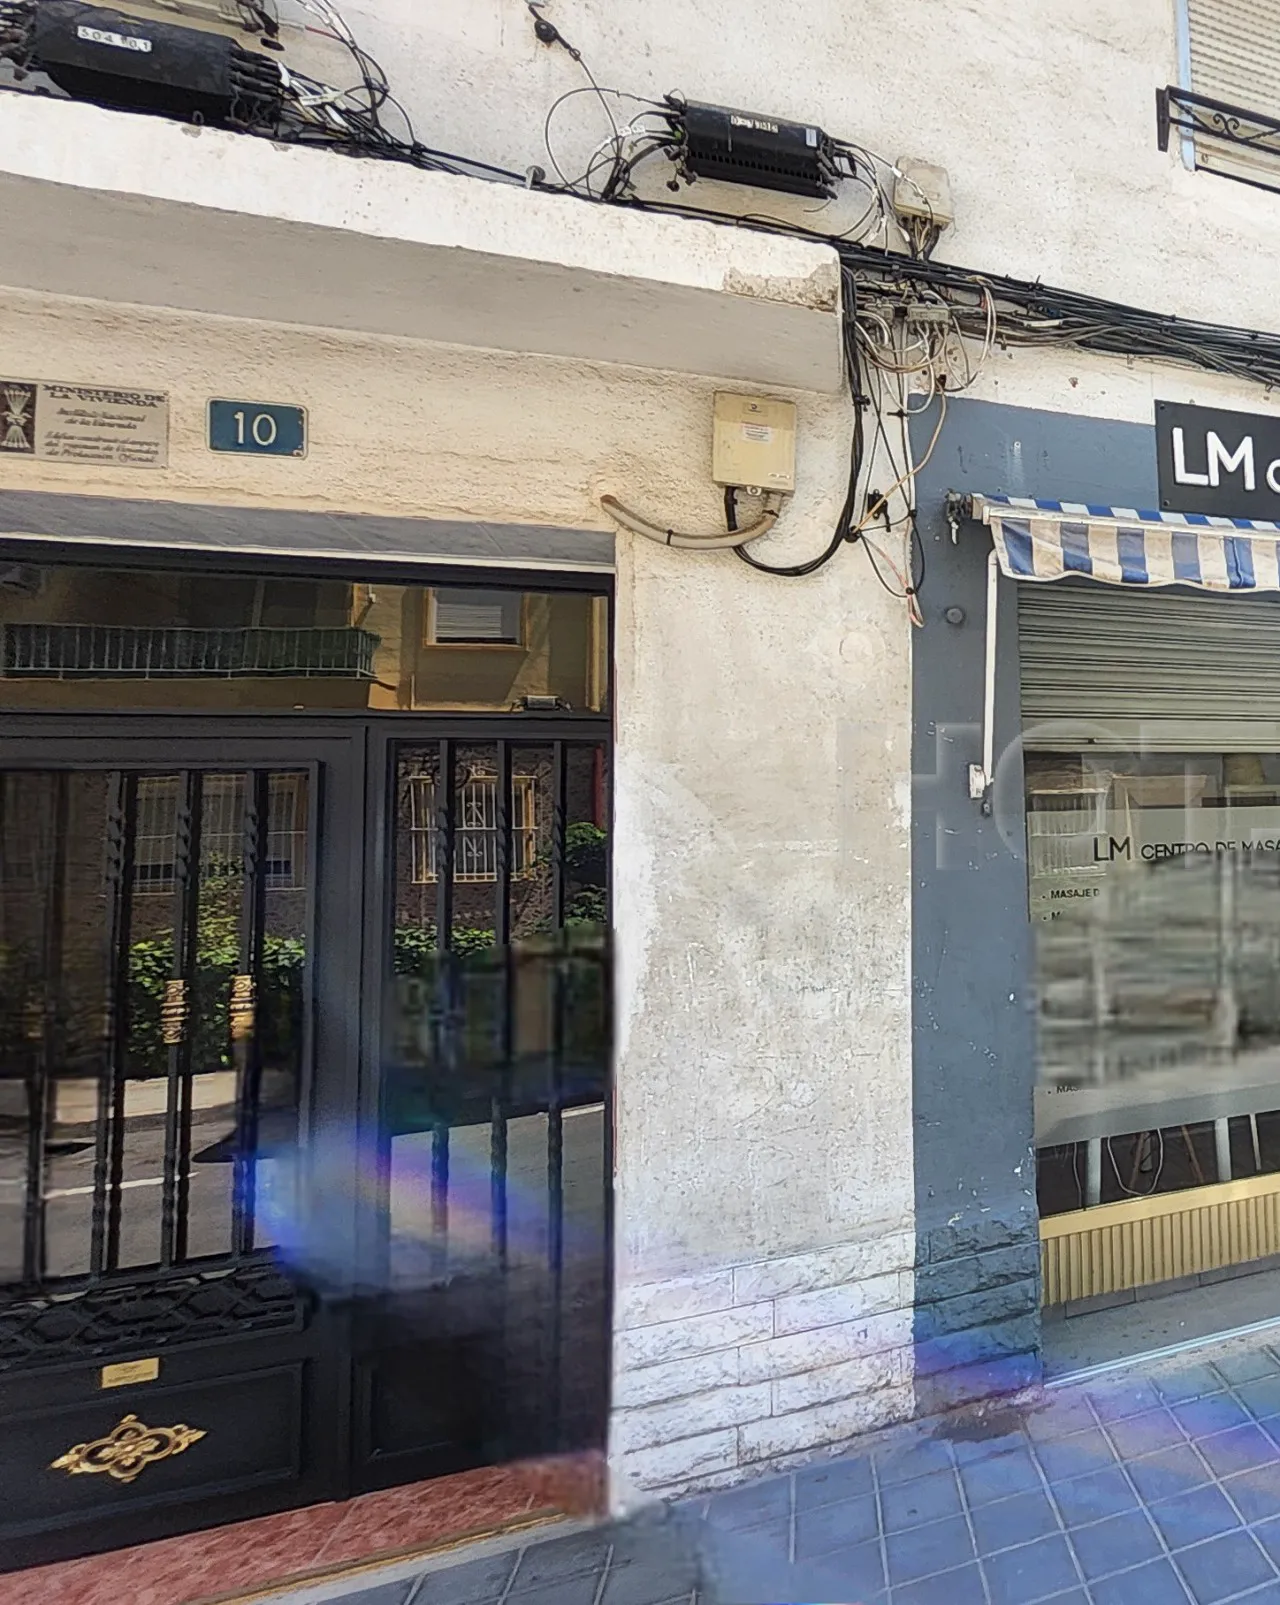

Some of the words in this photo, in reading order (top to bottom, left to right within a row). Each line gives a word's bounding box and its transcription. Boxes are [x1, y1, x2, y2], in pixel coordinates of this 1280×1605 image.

[42, 384, 141, 400] MINISTERIO
[144, 393, 166, 402] DE
[50, 391, 72, 400] LA
[77, 395, 159, 408] VIVIENDA
[233, 411, 277, 446] 10
[1171, 426, 1256, 491] LM
[1092, 836, 1132, 862] LM
[1050, 888, 1093, 899] MASAJE
